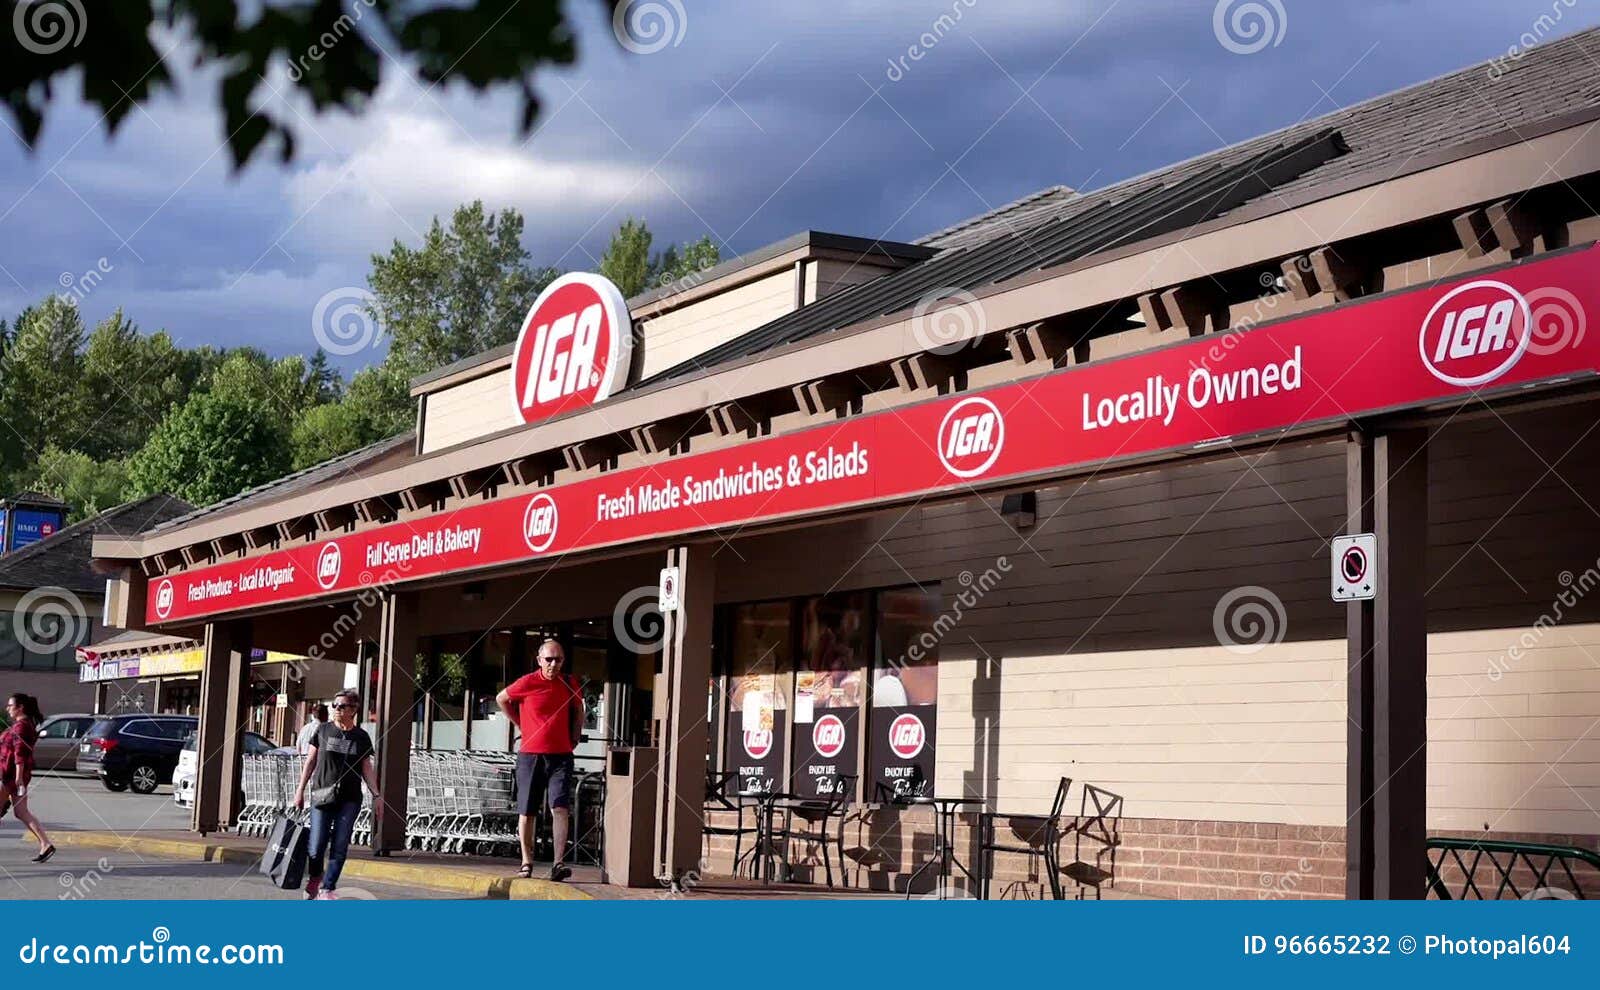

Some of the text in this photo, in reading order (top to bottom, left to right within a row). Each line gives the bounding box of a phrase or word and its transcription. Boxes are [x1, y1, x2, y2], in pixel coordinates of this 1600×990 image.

[1082, 345, 1302, 431] Locally Owned
[597, 441, 868, 521] Fresh Made Sandwiches & Salads
[366, 525, 482, 568] Full Serve Deli & Bakery
[188, 580, 206, 602] Fresh
[206, 577, 232, 599] Produce
[239, 568, 258, 592] Local
[258, 569, 265, 588] &
[264, 562, 295, 591] Organic
